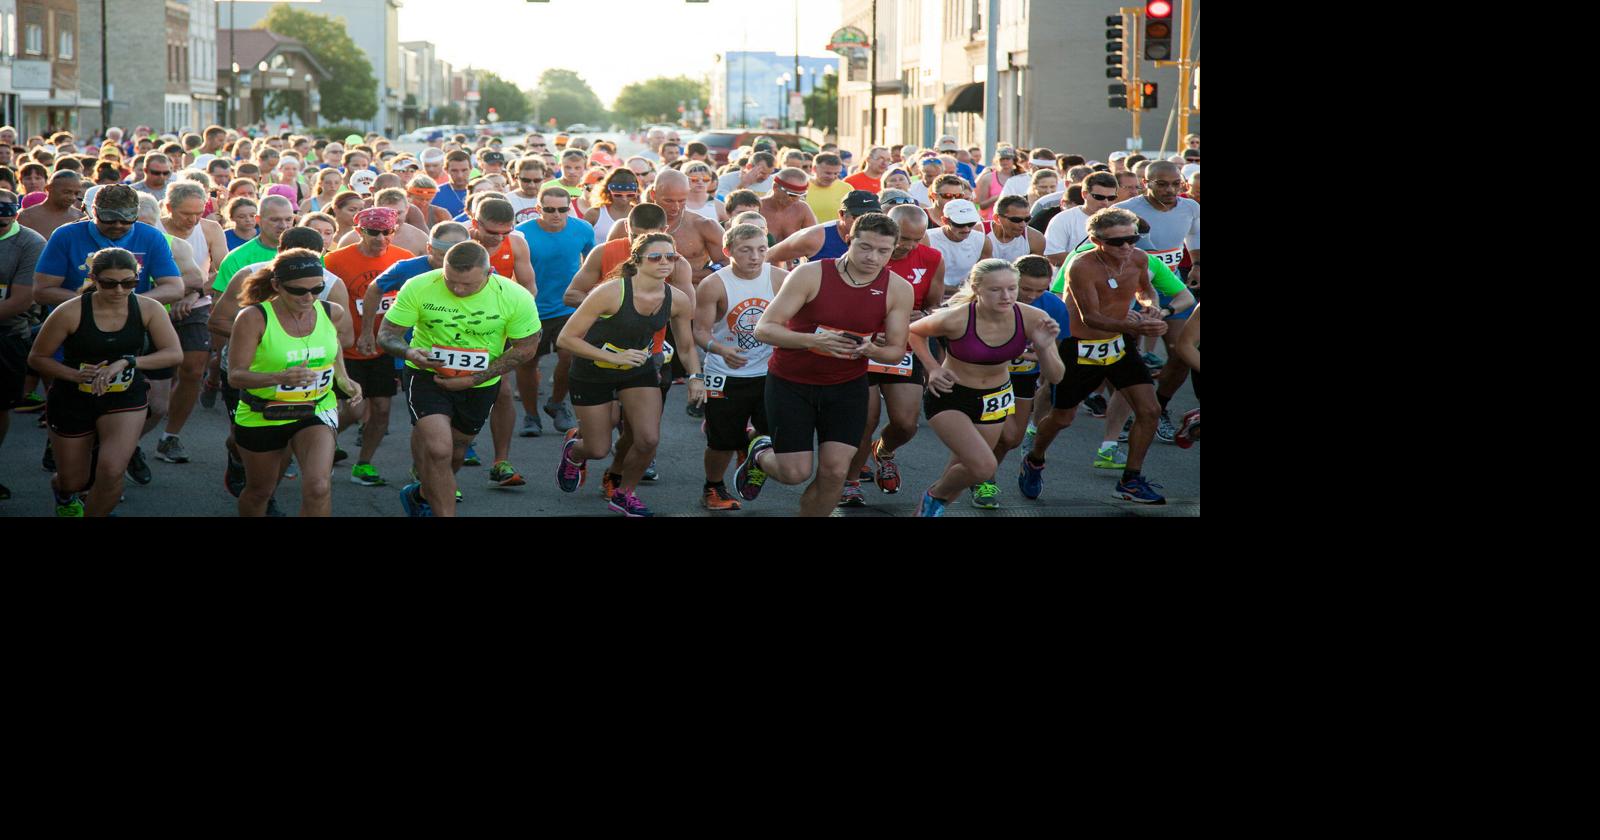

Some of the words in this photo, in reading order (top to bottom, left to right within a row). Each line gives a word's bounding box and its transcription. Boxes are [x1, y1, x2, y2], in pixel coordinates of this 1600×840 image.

[732, 300, 768, 316] TIGER
[1081, 339, 1121, 358] 791
[433, 351, 486, 369] 1132
